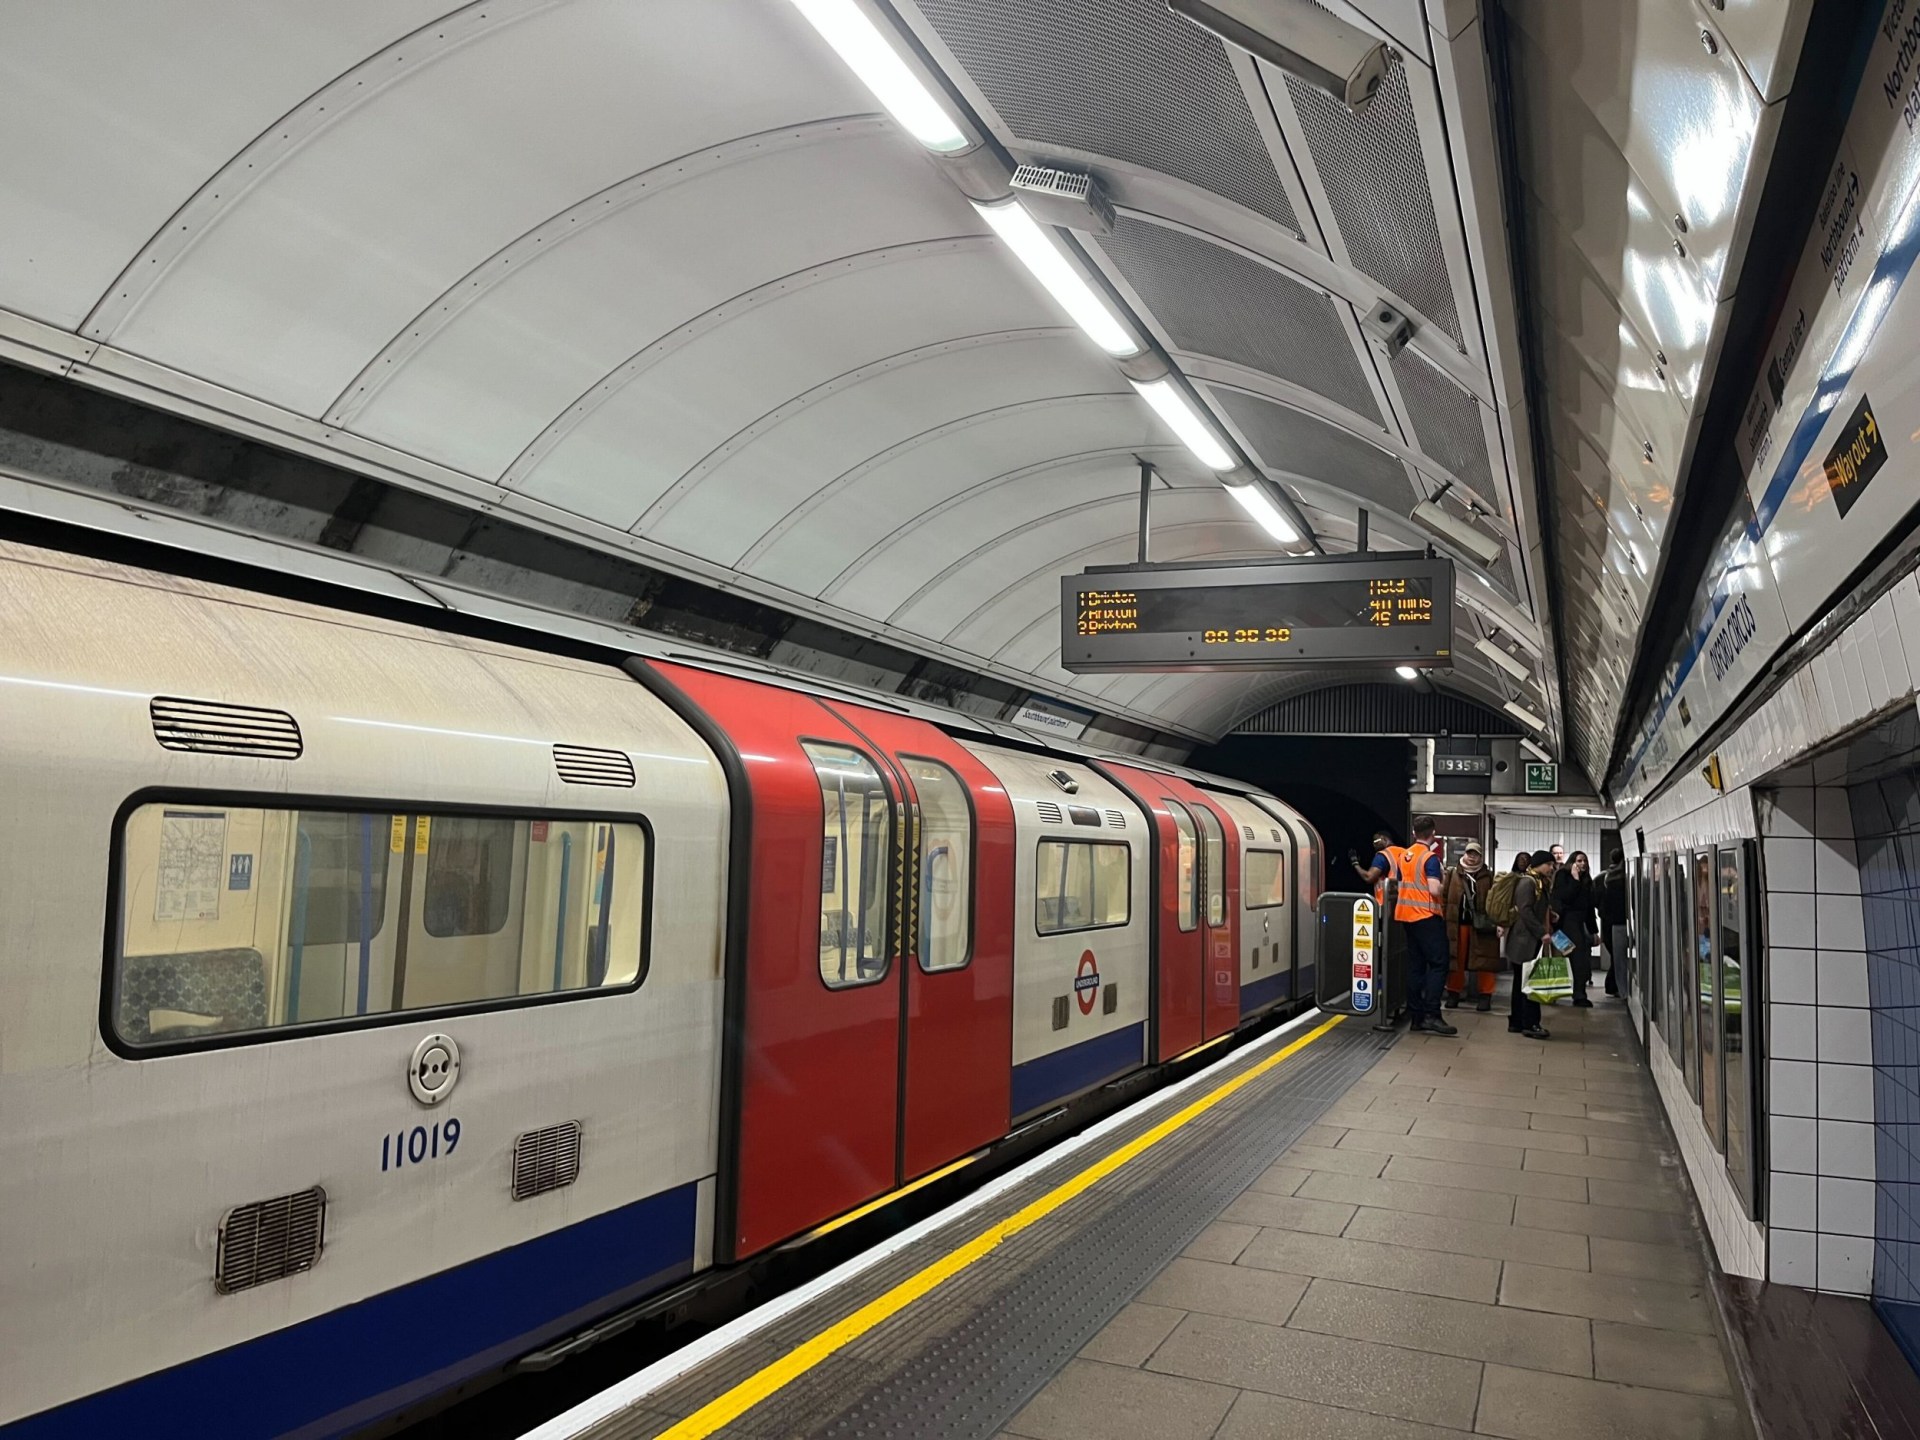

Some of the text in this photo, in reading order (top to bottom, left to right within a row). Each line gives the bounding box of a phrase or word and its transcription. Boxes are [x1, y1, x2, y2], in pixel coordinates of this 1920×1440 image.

[1821, 182, 1854, 272] Northbound
[1834, 214, 1864, 298] platform 4
[1834, 427, 1870, 487] Way out
[1709, 592, 1756, 681] OXFORD CIRCUS
[1075, 976, 1099, 989] UNDERGROUND
[382, 1117, 461, 1172] 11019
